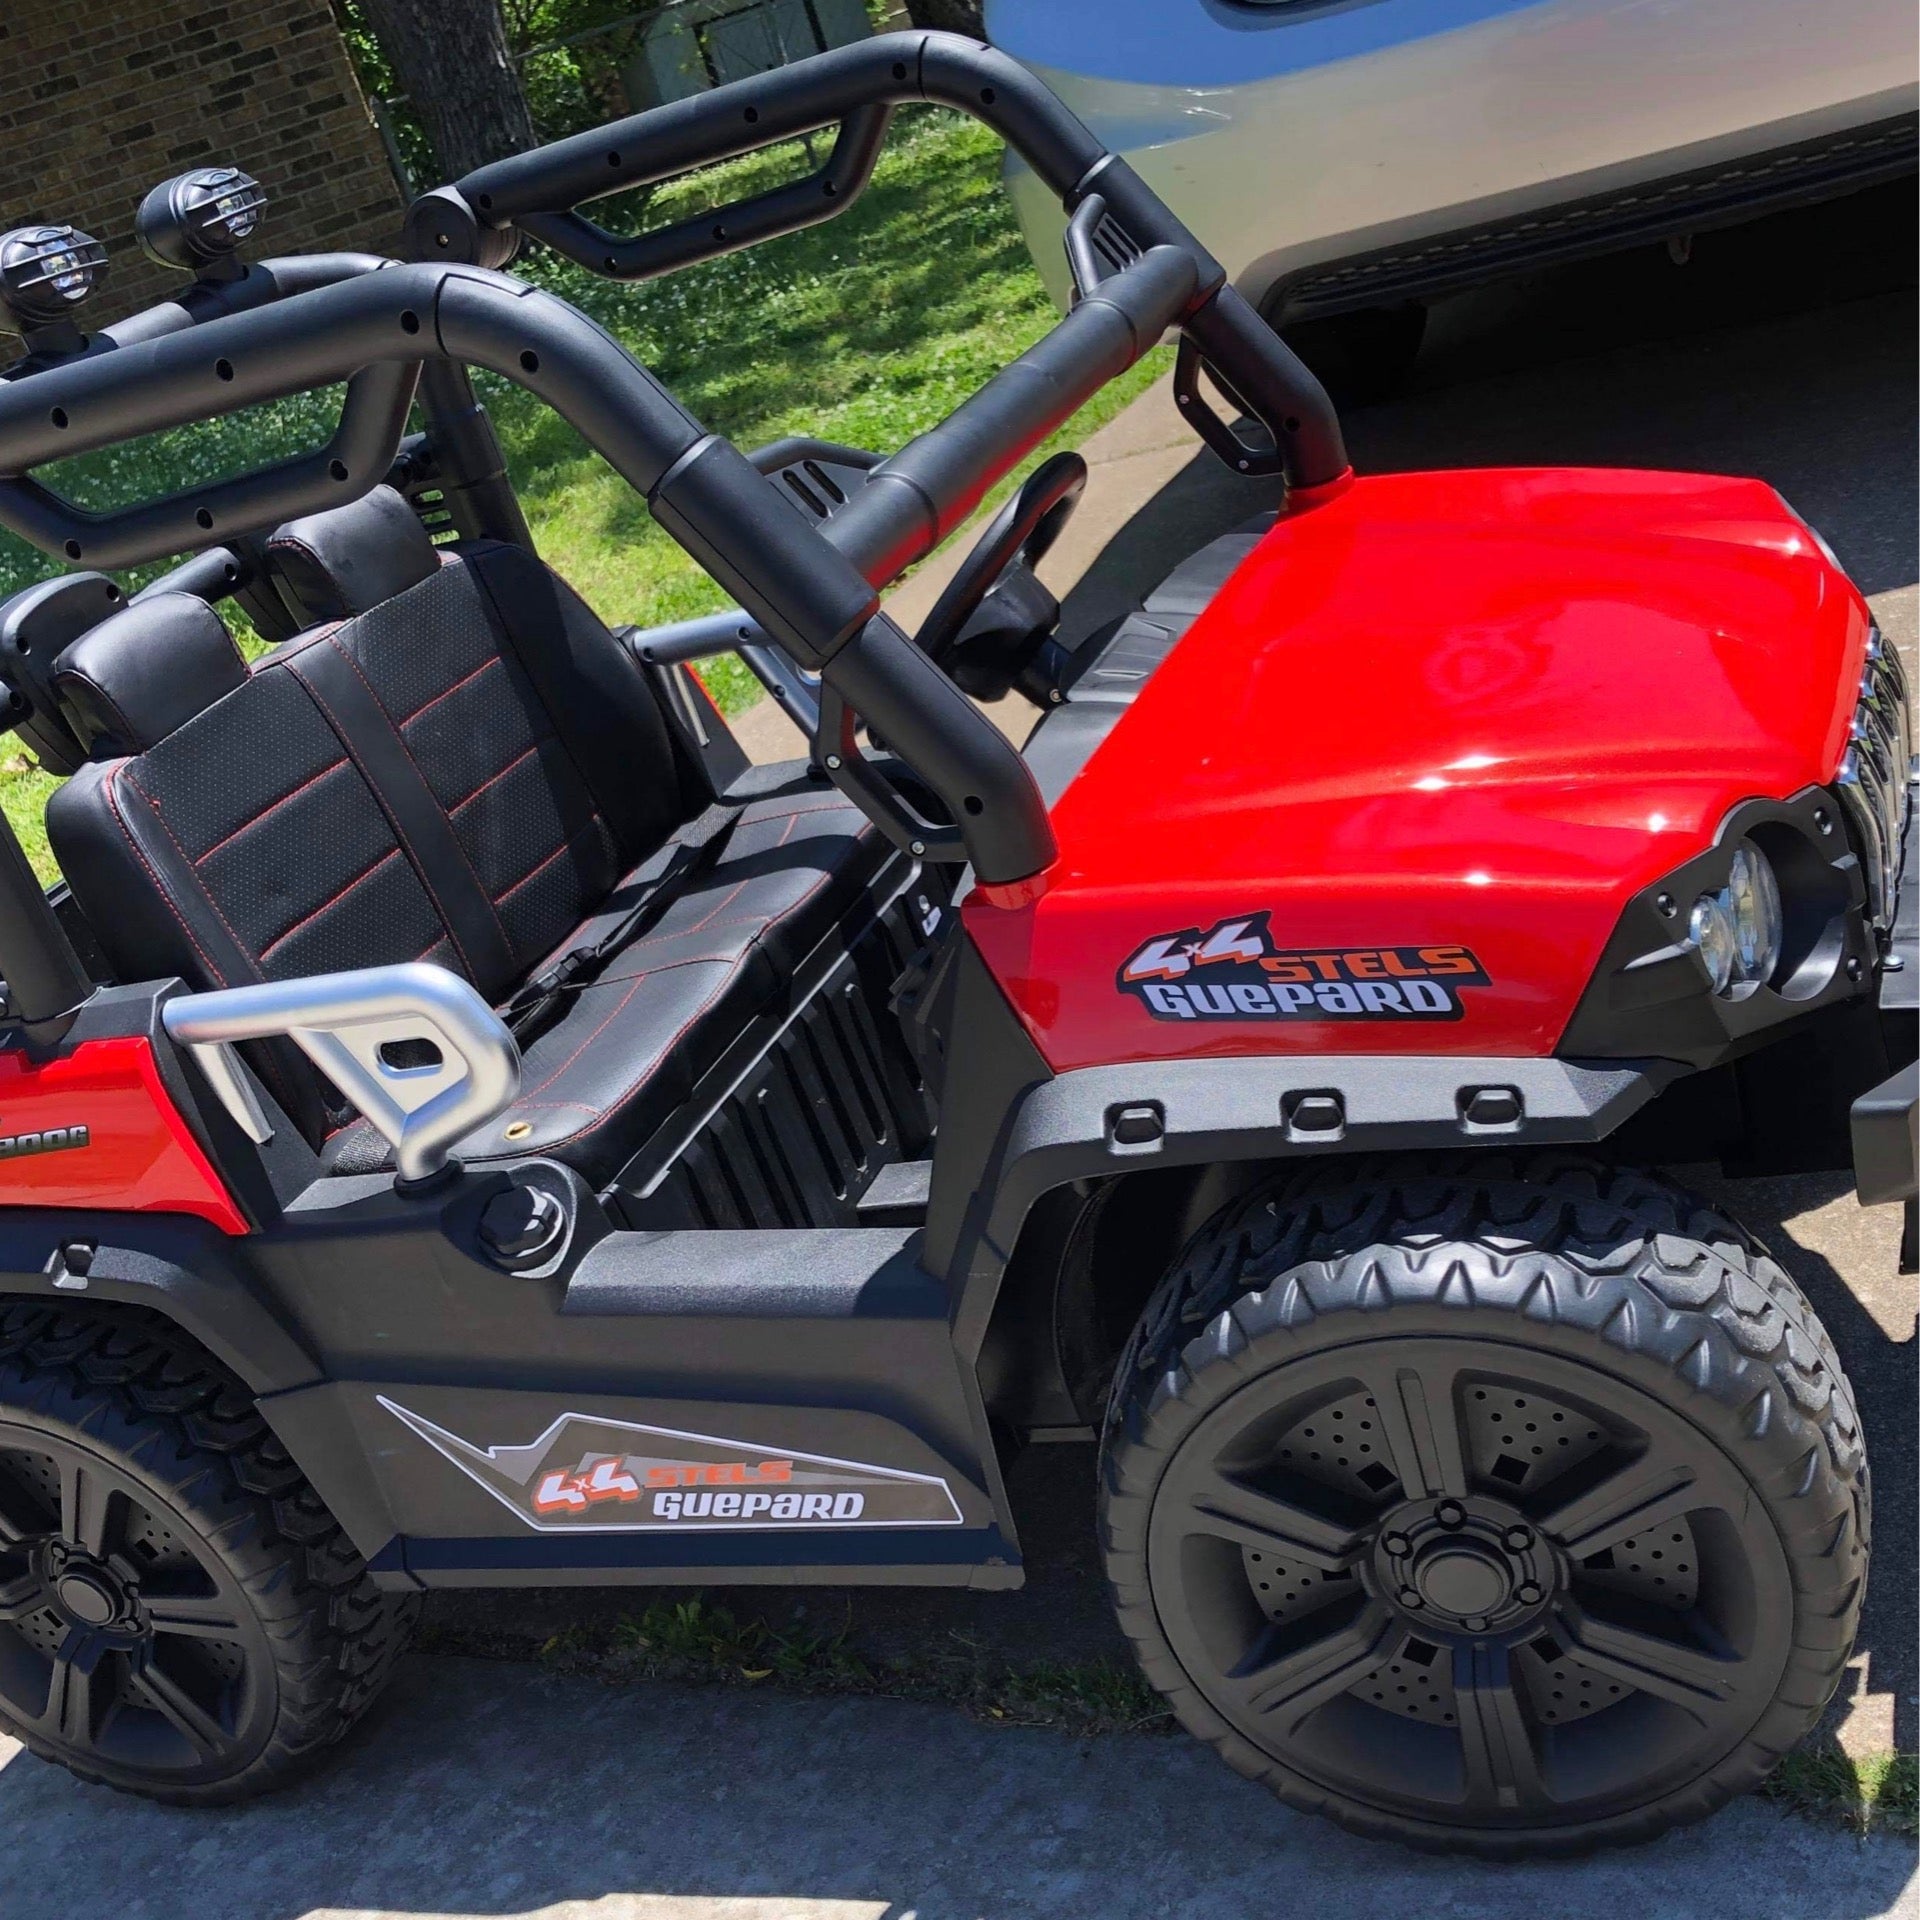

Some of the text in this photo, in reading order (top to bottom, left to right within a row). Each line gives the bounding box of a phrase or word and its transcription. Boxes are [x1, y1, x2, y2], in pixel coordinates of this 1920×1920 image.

[1124, 920, 1476, 981] 4x4 STELS
[533, 1458, 793, 1514] 4x4 STELS
